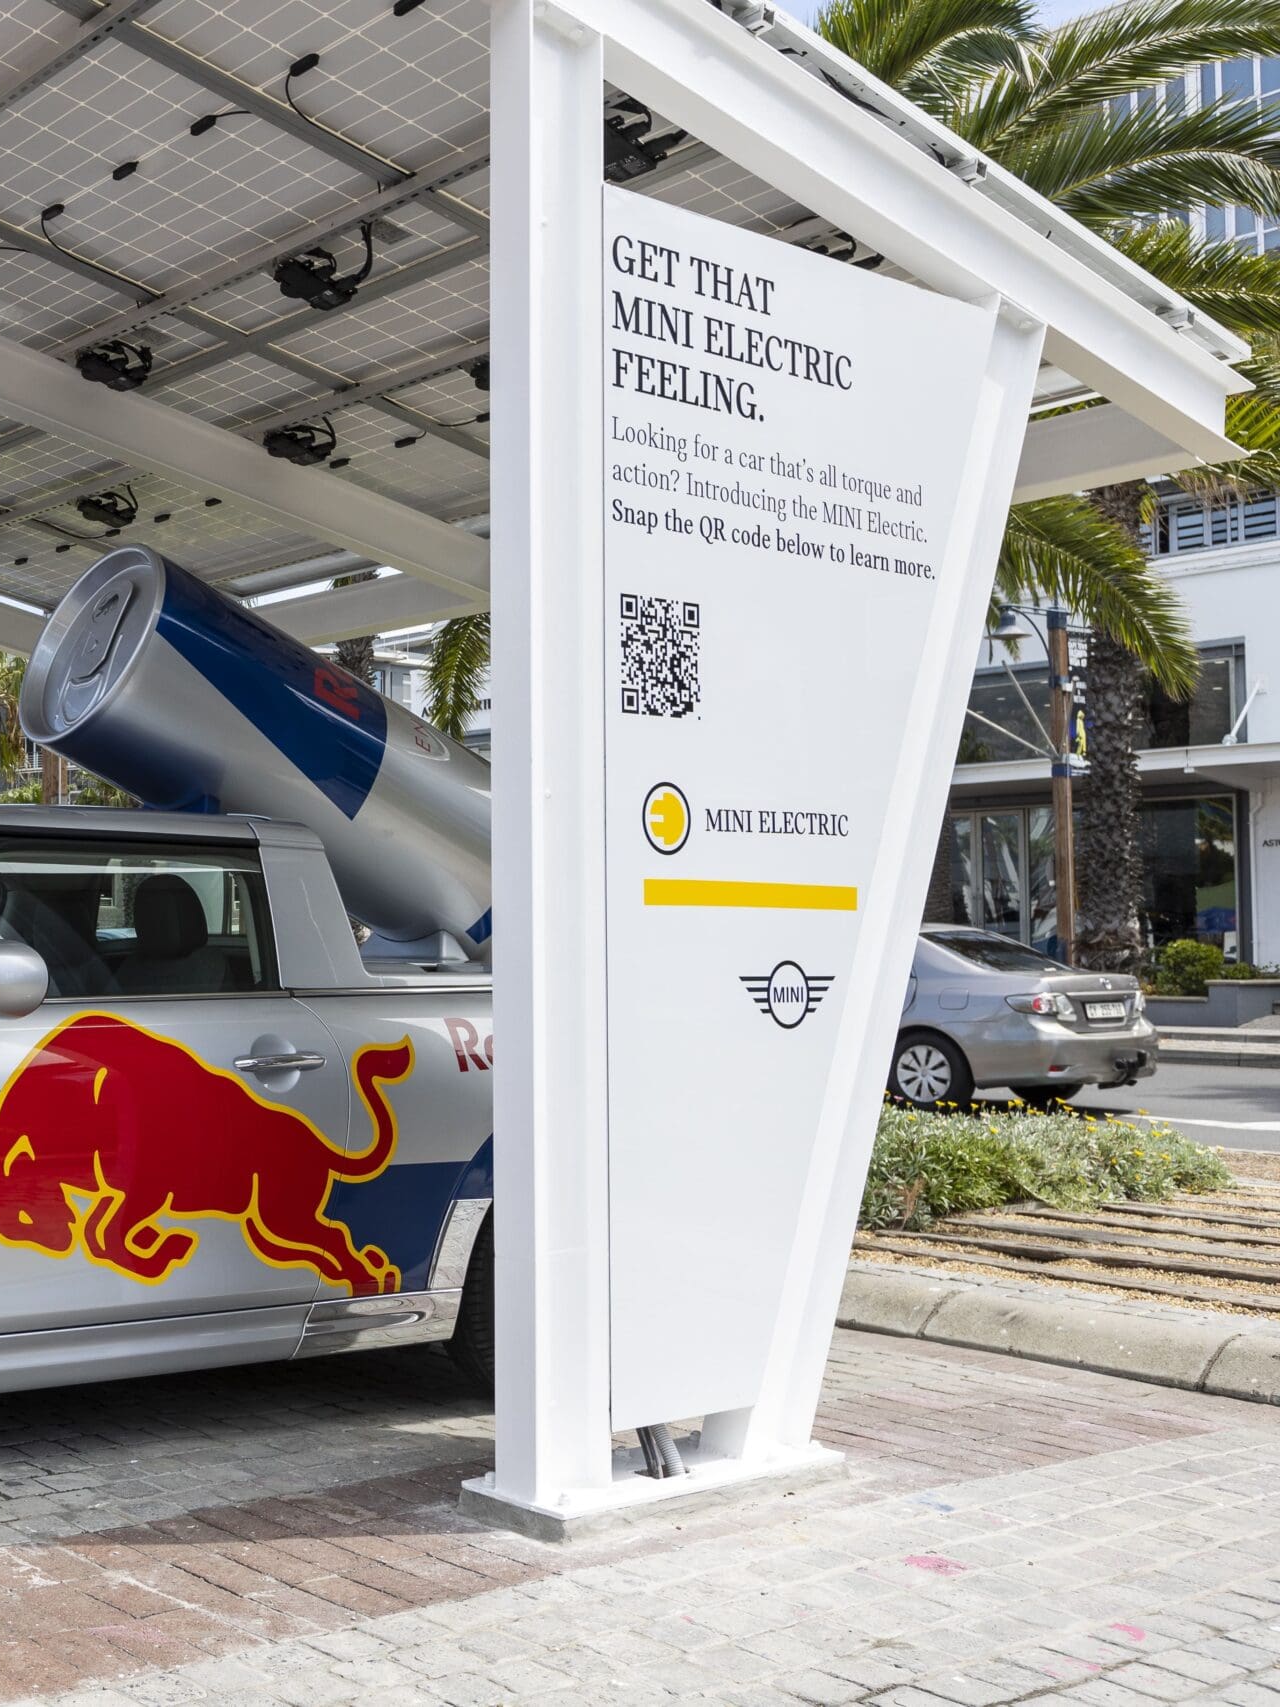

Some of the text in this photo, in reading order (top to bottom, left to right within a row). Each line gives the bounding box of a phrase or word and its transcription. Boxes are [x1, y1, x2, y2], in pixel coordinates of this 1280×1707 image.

[612, 235, 774, 315] GET THAT
[612, 290, 852, 390] MINI ELECTRIC
[612, 348, 764, 422] FEELING.
[612, 416, 922, 507] Looking for a car that’s all torque and
[612, 498, 935, 580] Snap the QR code below to learn more.
[613, 463, 927, 543] action? Introducing the MINI Electric.
[705, 808, 849, 836] MINI ELECTRIC
[773, 986, 804, 1003] MINI
